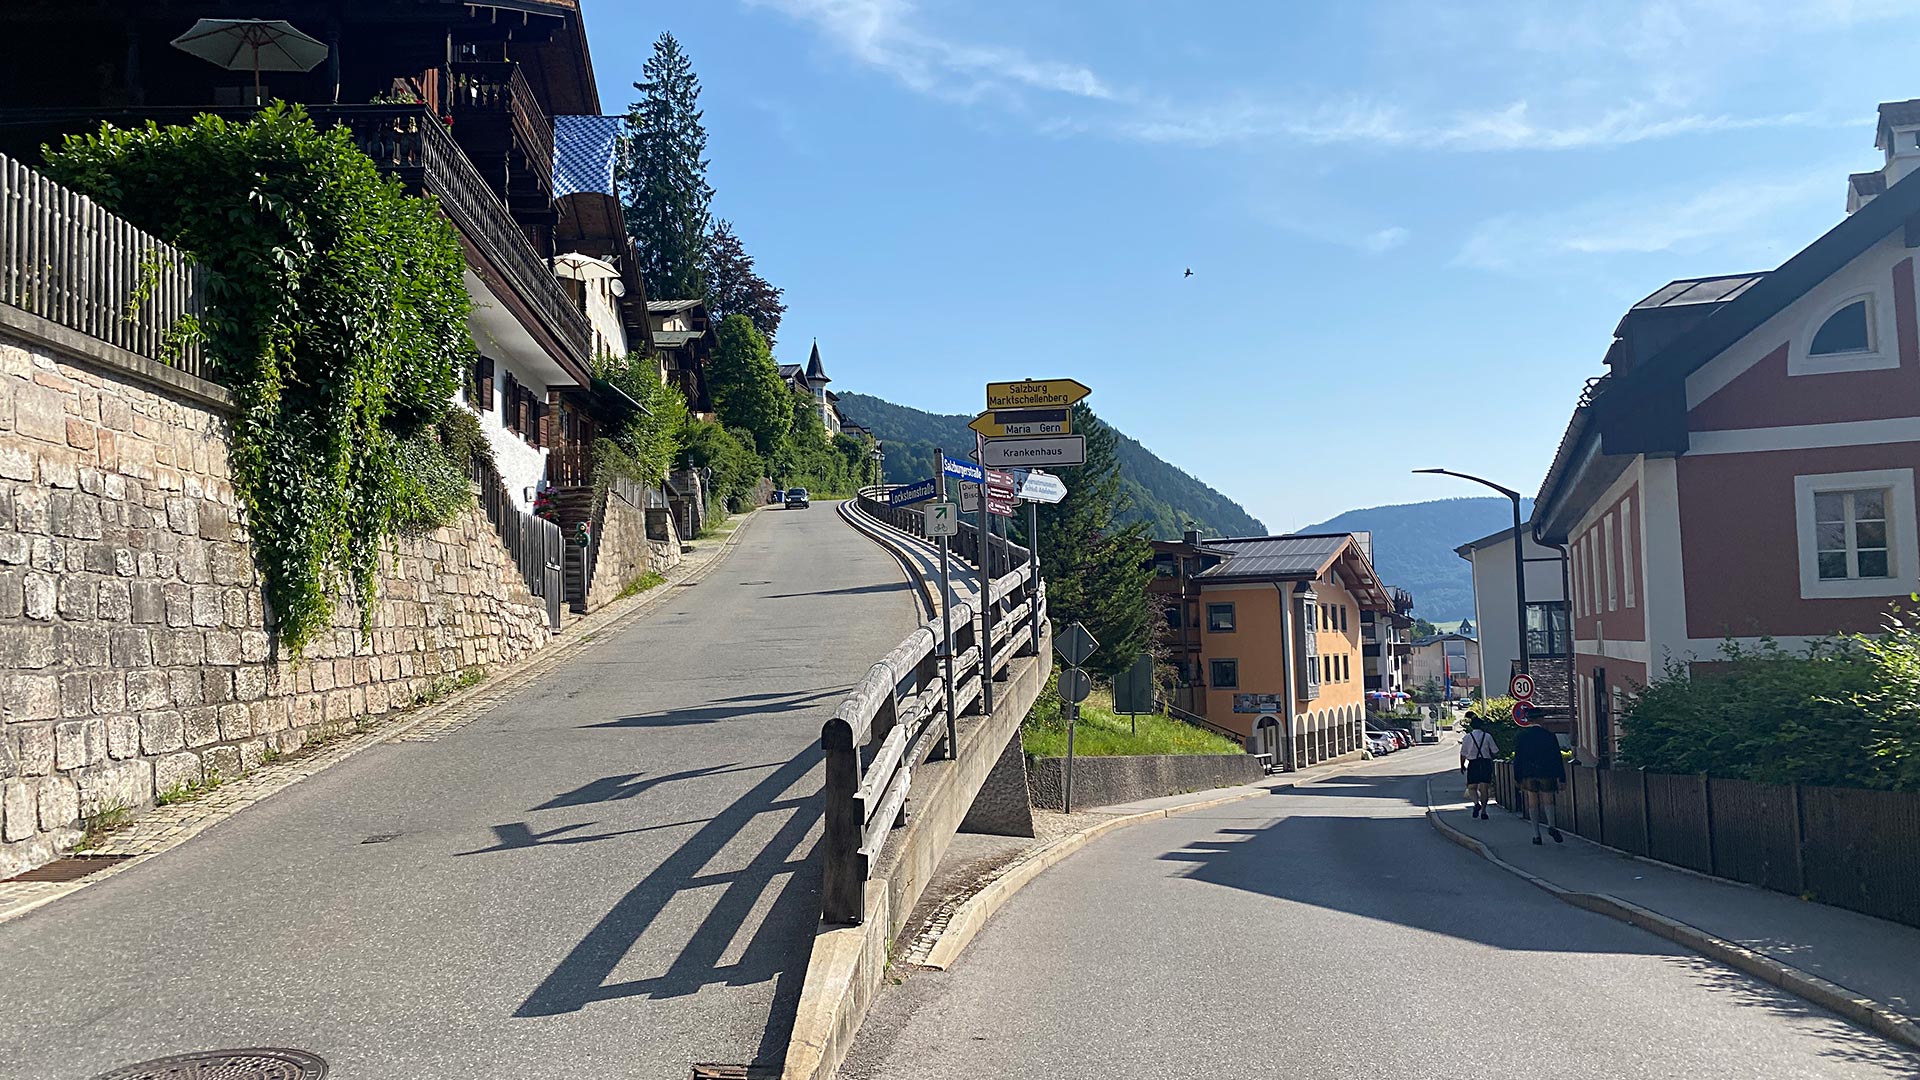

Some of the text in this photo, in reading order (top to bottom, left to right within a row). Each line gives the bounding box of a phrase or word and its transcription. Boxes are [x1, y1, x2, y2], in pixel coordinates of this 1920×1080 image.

[1009, 384, 1048, 394] Salzburg
[989, 394, 1069, 406] Marktschellenberg
[1006, 424, 1061, 434] Maria Gern
[1003, 447, 1063, 457] Krankenhaus
[943, 458, 982, 480] Salzburgerstraße
[891, 482, 935, 505] Locksteinstraße
[963, 492, 978, 500] Bisc
[1516, 681, 1529, 693] 30
